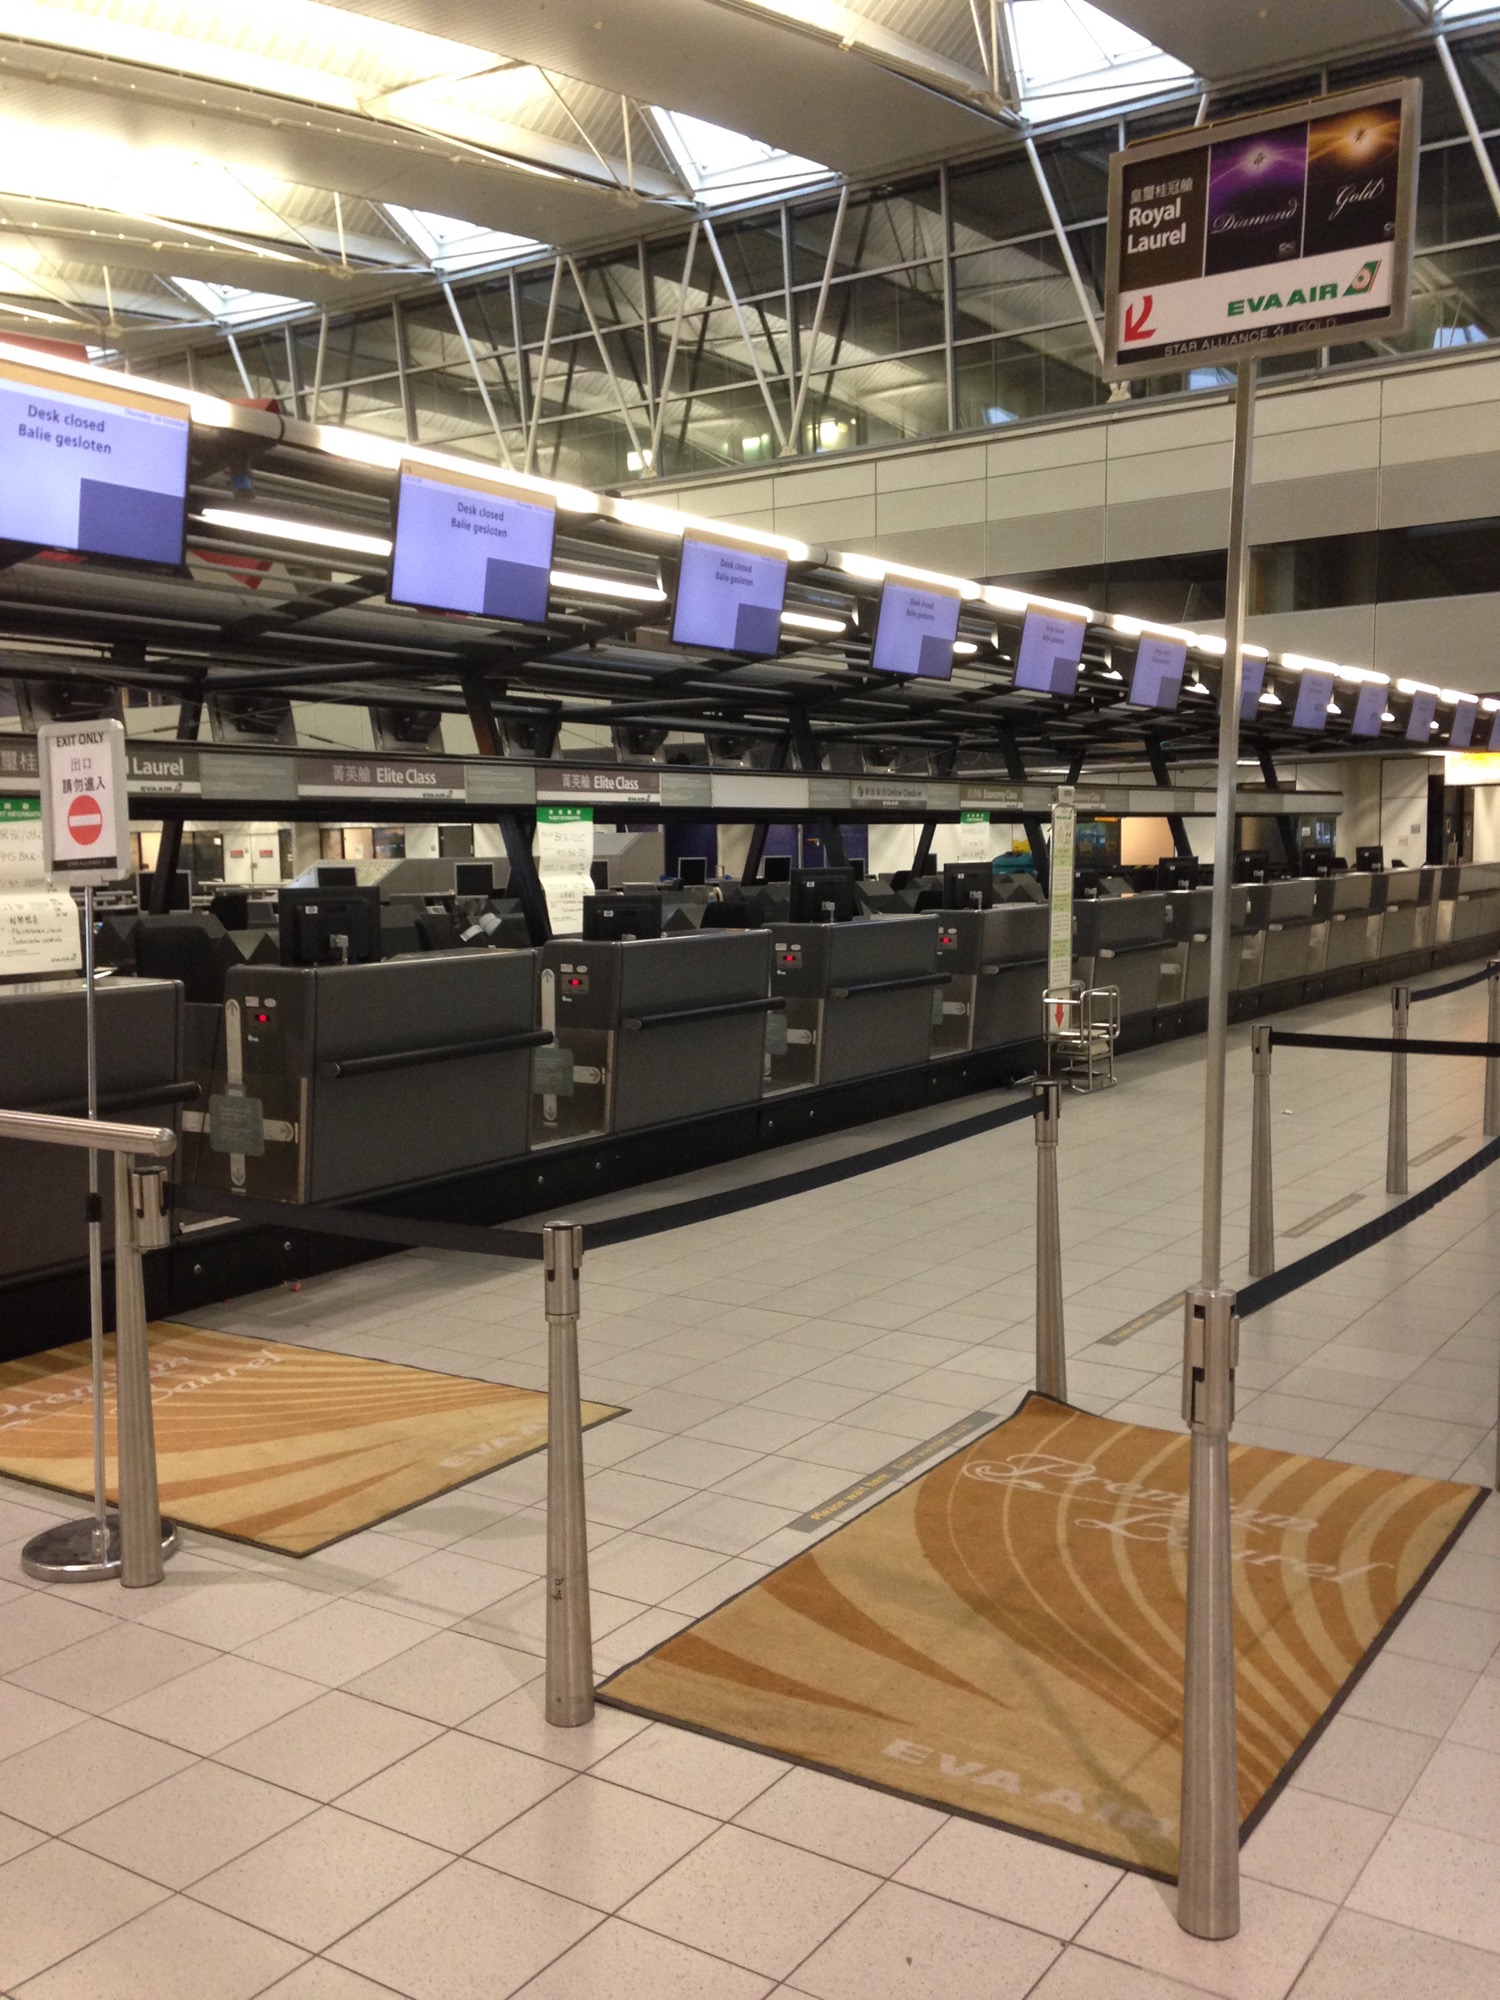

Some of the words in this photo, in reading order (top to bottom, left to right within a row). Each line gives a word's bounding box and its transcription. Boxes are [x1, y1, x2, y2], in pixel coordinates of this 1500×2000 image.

[1128, 197, 1181, 228] Royal
[1328, 178, 1384, 220] Gold
[1210, 200, 1297, 234] Diamond
[1127, 222, 1187, 254] Laurel
[1227, 292, 1284, 317] EVA
[1285, 283, 1339, 306] AIR
[1164, 340, 1197, 357] STAR
[1201, 328, 1272, 350] ALLIANCE
[1296, 318, 1336, 334] GOLD
[28, 405, 61, 422] Desk
[64, 414, 105, 432] closed
[19, 424, 52, 441] Balie
[55, 434, 112, 453] gesloten
[457, 502, 476, 515] Desk
[479, 508, 504, 521] closed
[451, 517, 471, 530] Balie
[474, 524, 508, 537] gesloten
[56, 736, 79, 748] EXIT
[80, 732, 104, 746] ONLY
[71, 757, 92, 771] 出口
[133, 757, 184, 777] Laurel
[376, 767, 404, 783] Elite
[406, 768, 437, 785] Class
[63, 776, 105, 794] 請勿進入
[594, 776, 614, 789] Elite
[616, 776, 639, 790] Class
[884, 1738, 1021, 1795] EVA
